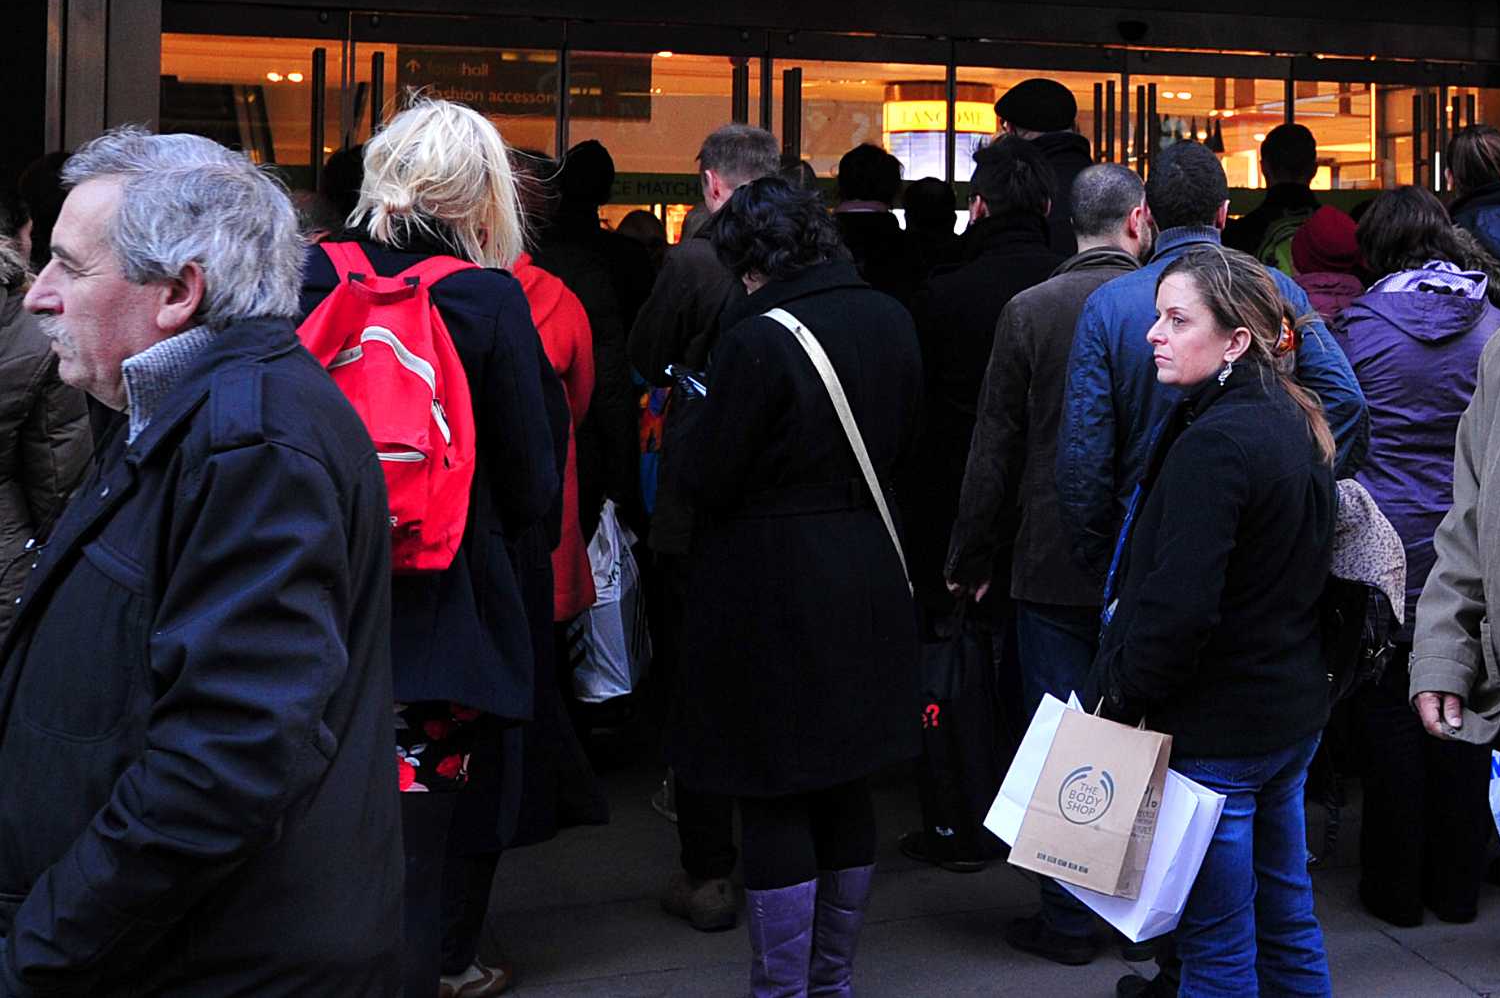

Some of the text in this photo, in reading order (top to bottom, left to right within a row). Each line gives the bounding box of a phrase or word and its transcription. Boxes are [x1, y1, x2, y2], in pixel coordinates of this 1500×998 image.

[427, 83, 559, 105] ashion accessor
[1080, 782, 1099, 797] THE
[1067, 790, 1104, 809] BODY
[1065, 800, 1096, 818] SHOP
